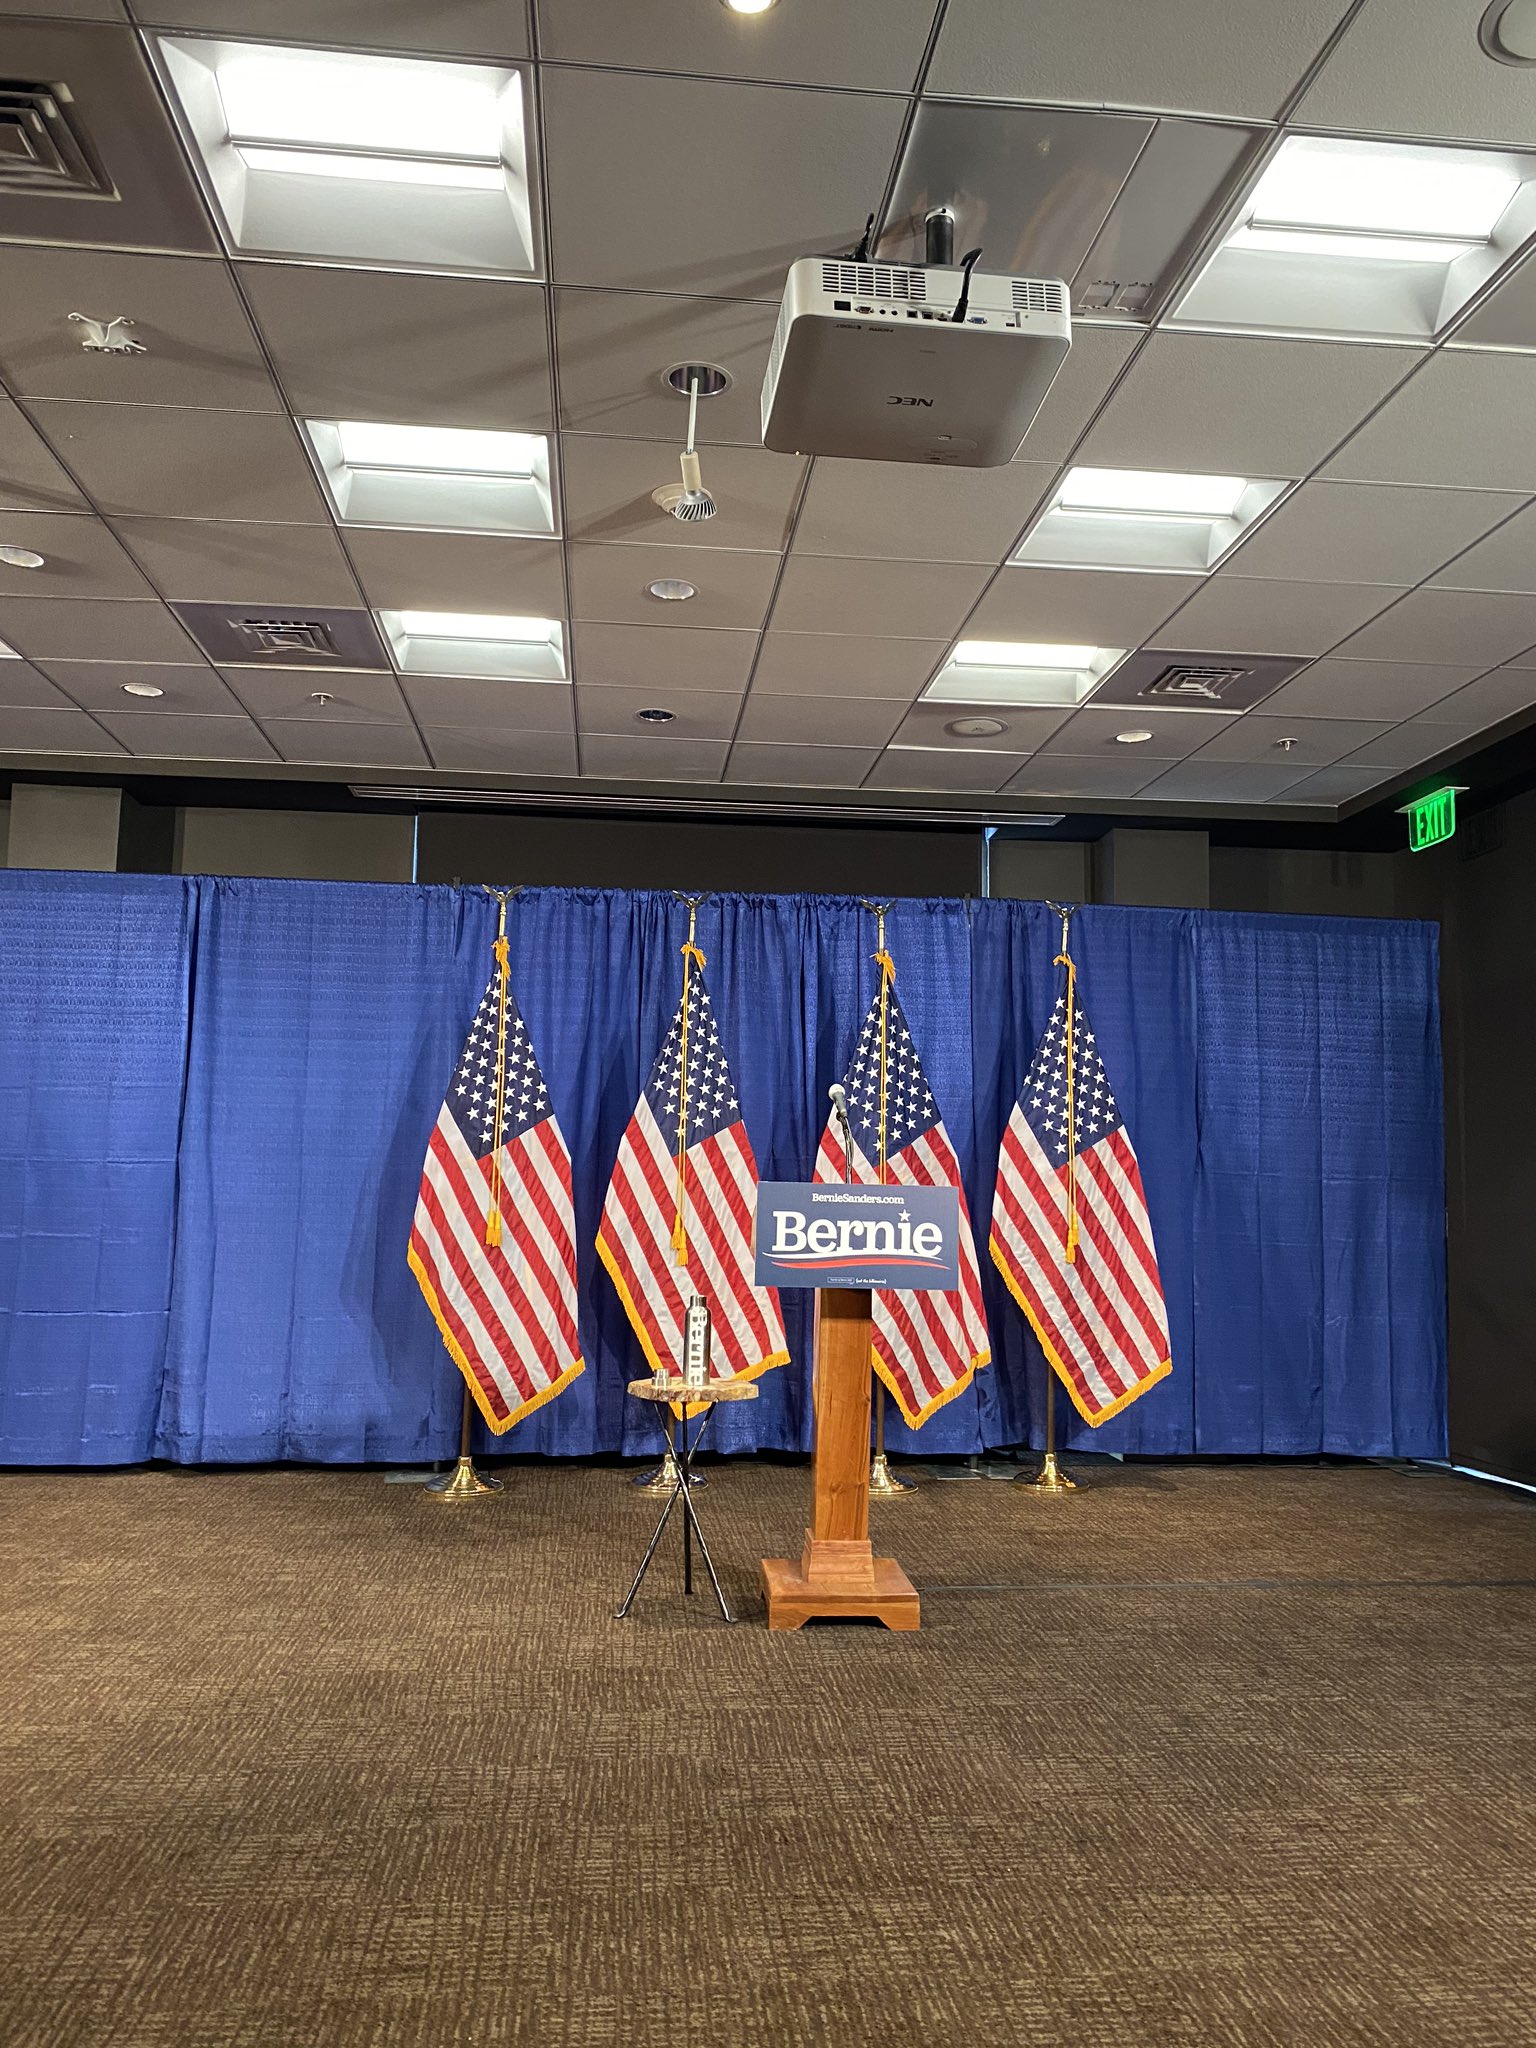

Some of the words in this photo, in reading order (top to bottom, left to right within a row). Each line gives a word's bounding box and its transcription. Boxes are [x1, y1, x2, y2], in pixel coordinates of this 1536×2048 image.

[886, 395, 934, 407] NEC
[1416, 796, 1447, 846] EXIT
[812, 1193, 905, 1205] BernieSanders.com
[772, 1209, 943, 1257] Bernie
